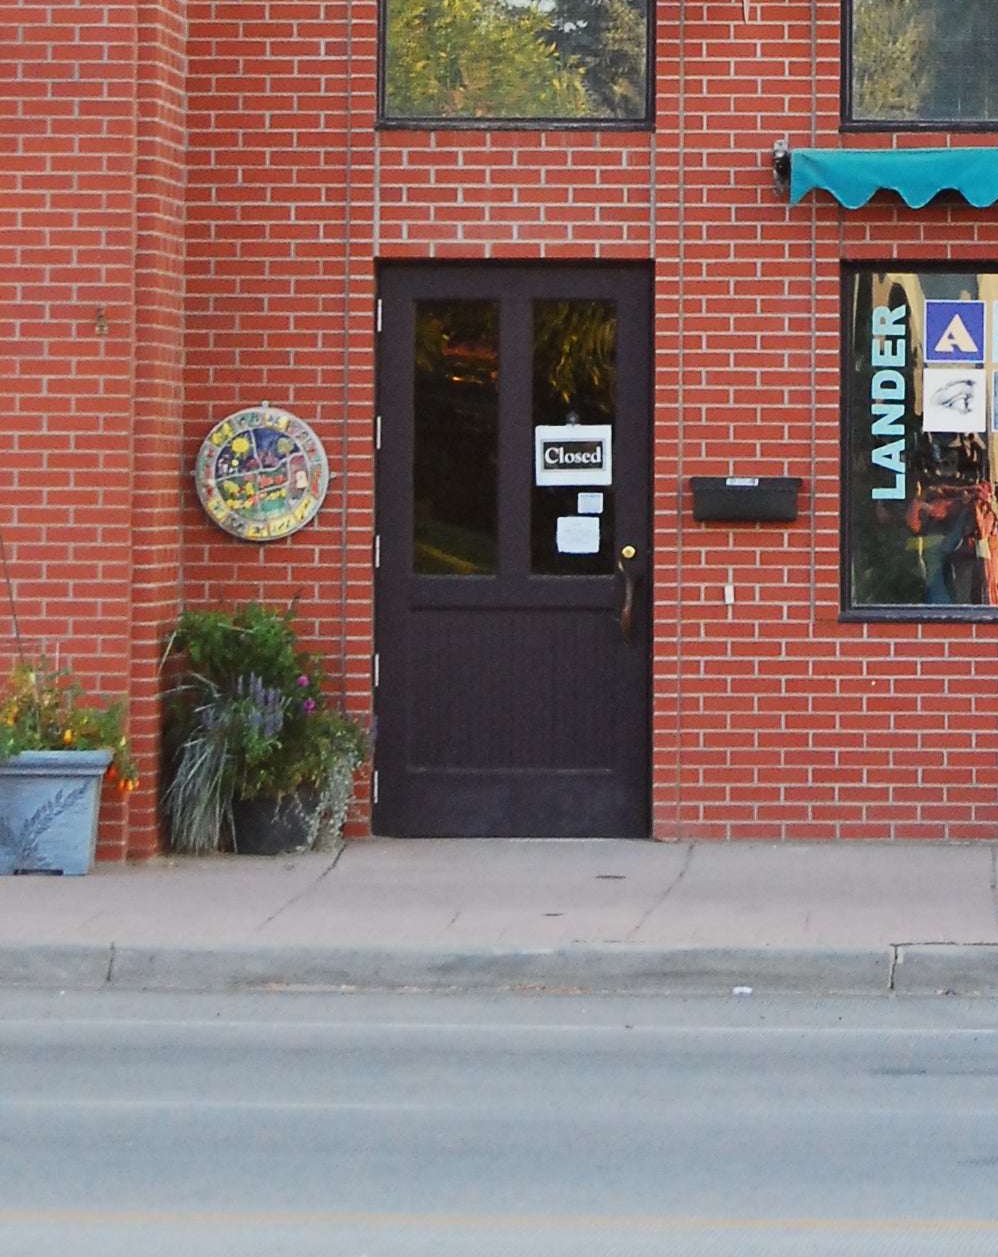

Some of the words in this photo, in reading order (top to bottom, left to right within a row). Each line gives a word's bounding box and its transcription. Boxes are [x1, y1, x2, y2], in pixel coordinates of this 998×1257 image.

[934, 313, 979, 353] A
[871, 304, 907, 500] LANDER
[544, 446, 603, 465] Closed
